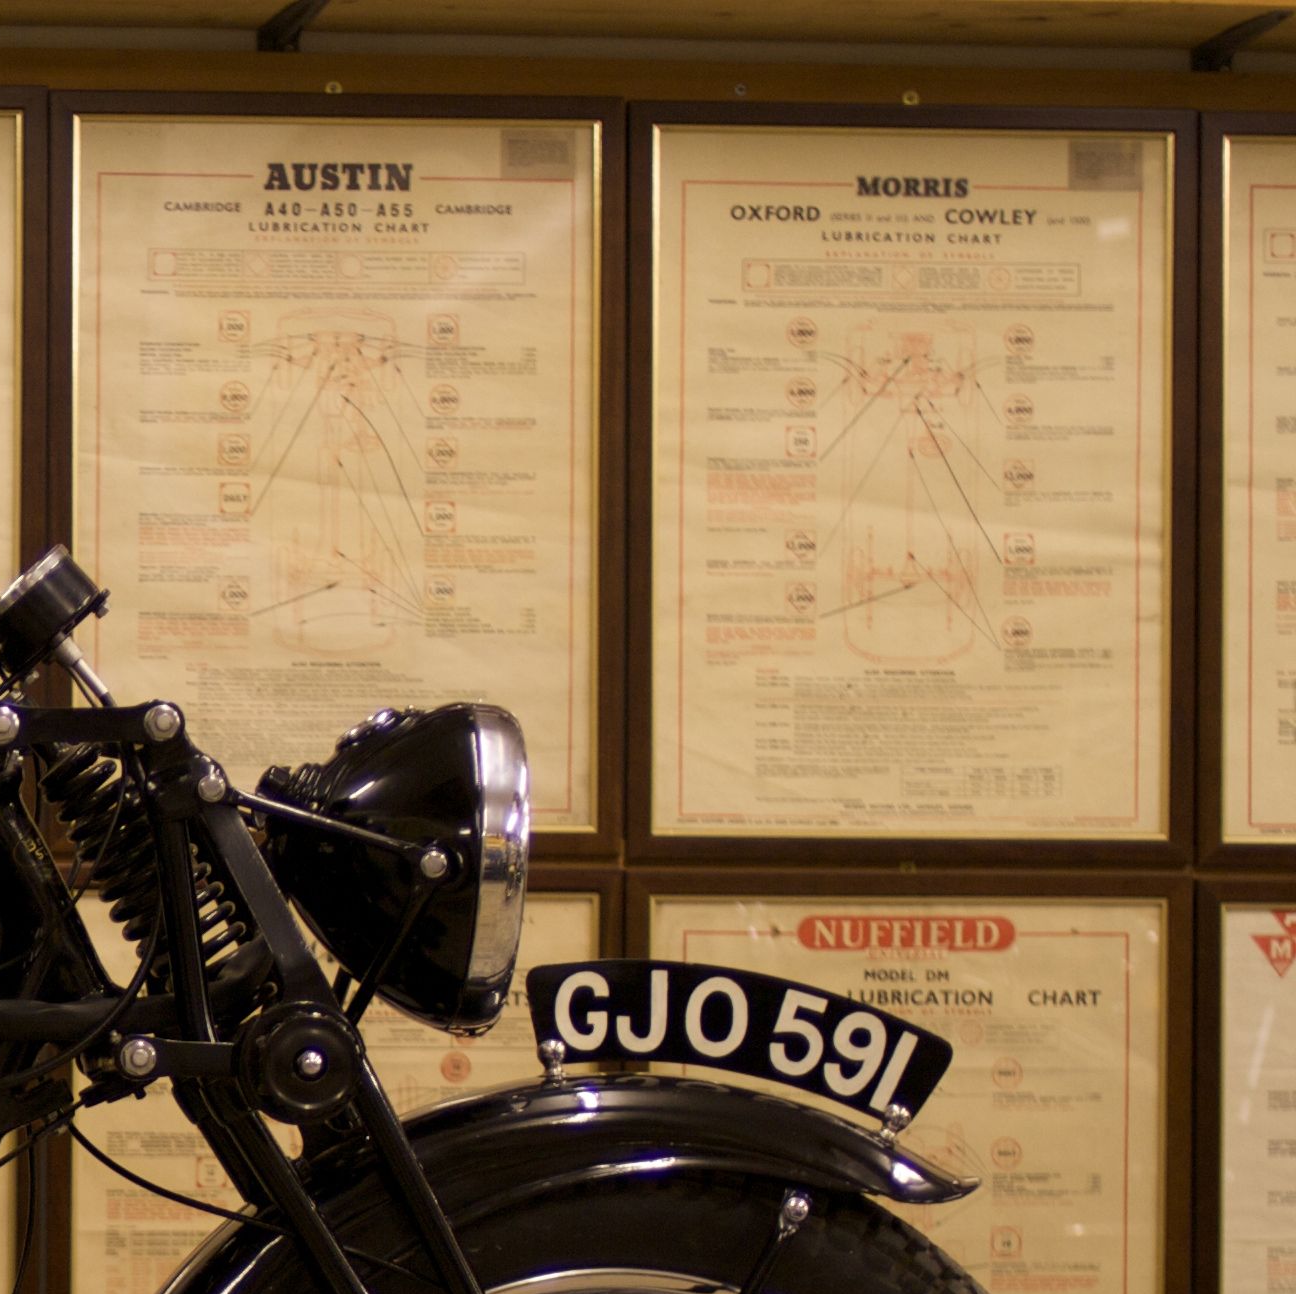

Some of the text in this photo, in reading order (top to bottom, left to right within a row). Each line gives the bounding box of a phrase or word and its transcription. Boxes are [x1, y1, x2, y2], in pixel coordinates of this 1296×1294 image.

[264, 163, 413, 192] AUSTIN
[857, 177, 969, 198] MORRIS
[164, 200, 242, 213] CAMBRIDGE
[435, 204, 513, 216] CAMBRIDGE
[731, 205, 821, 222] OXFORD
[944, 208, 1037, 225] COWLEY
[248, 222, 430, 235] LUBRICATION CHART
[821, 231, 1002, 244] LUBRICATION CHART
[814, 919, 1000, 949] NUFFIELD
[864, 969, 950, 982] MODEL DM
[1028, 990, 1102, 1007] CHART
[553, 968, 919, 1110] GJO 591
